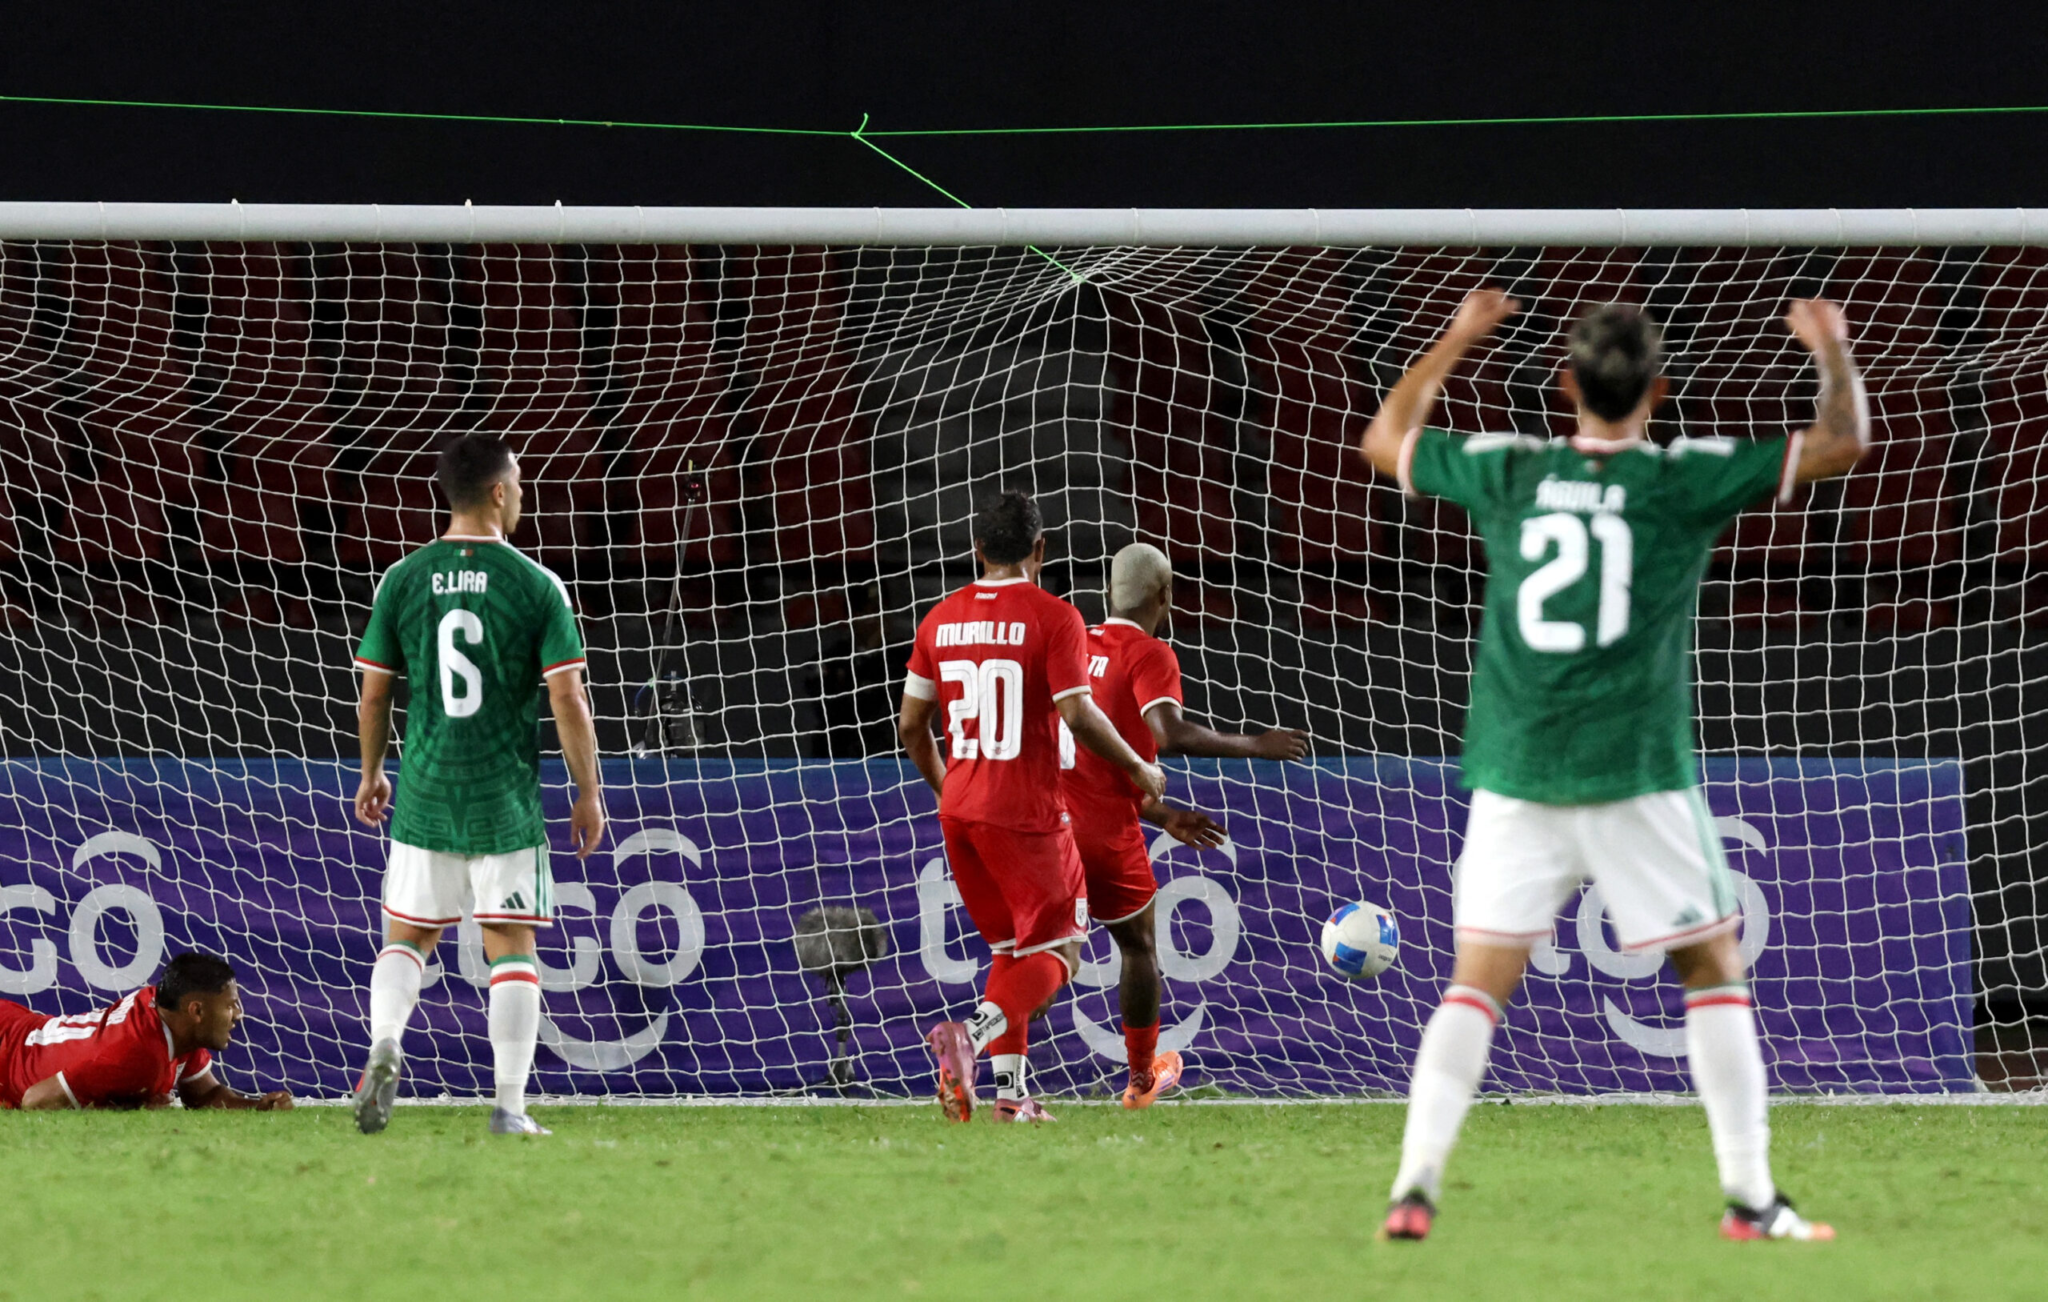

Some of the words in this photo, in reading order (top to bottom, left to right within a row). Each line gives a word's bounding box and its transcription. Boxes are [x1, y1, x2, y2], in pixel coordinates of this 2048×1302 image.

[431, 570, 488, 595] E.LIRA
[1517, 512, 1633, 653] 21
[437, 608, 484, 718] 6
[935, 621, 1026, 647] MURILLO
[938, 659, 1023, 761] 20
